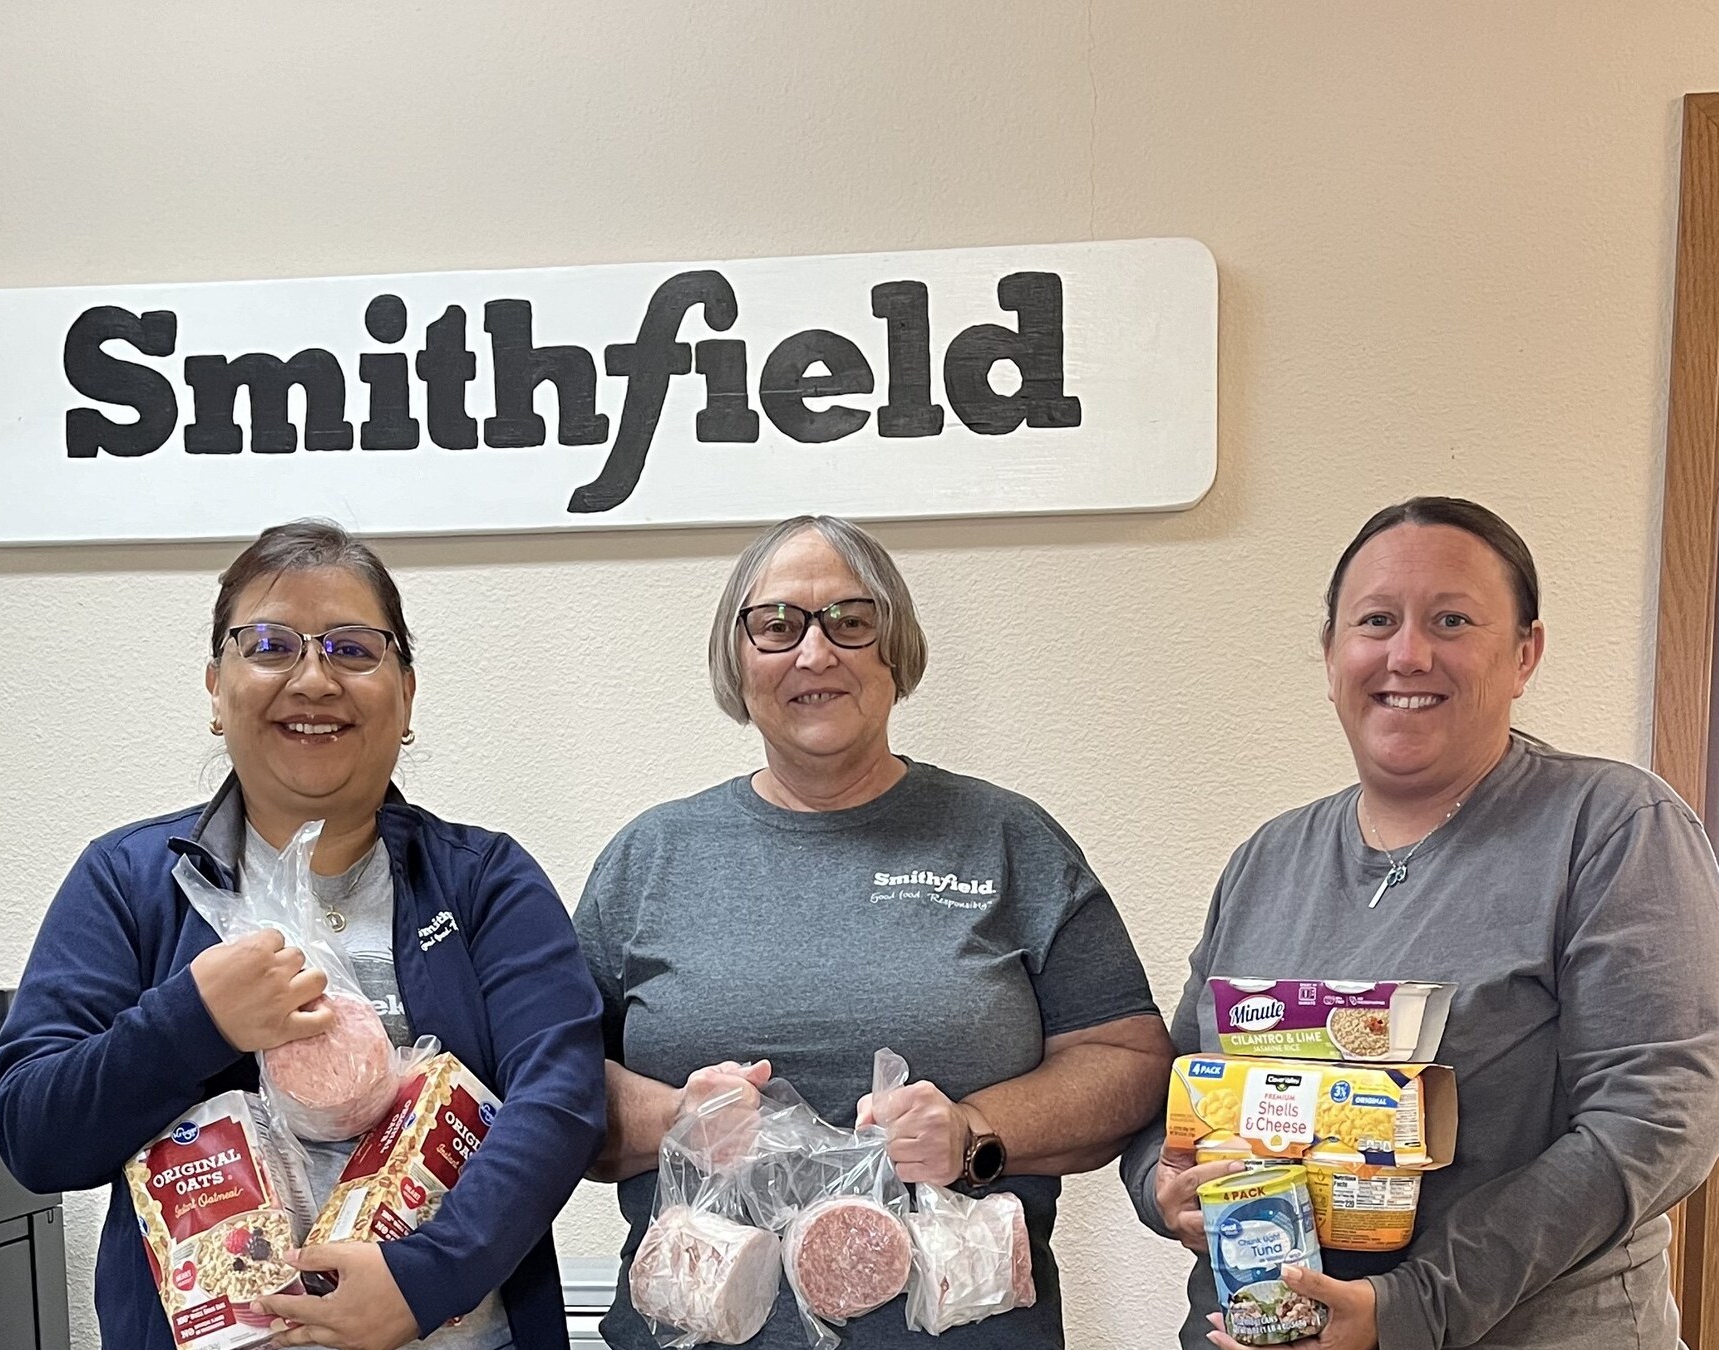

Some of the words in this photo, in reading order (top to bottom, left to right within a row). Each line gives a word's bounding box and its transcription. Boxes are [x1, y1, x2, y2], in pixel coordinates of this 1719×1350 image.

[64, 269, 1082, 515] Smithfield
[870, 891, 895, 904] Good
[1230, 1000, 1285, 1027] Minute
[1231, 1034, 1284, 1046] CILANTRO
[1286, 1033, 1295, 1044] &
[1296, 1031, 1323, 1043] LIME
[1253, 1044, 1282, 1053] JASMINE
[1283, 1043, 1301, 1052] RICE
[1191, 1063, 1200, 1075] 4
[1200, 1065, 1222, 1075] PACK
[1264, 1092, 1296, 1100] PREMIUM
[1355, 1096, 1387, 1106] ORIGINAL
[1258, 1101, 1299, 1118] Shells
[444, 1110, 482, 1152] ORIGI
[1245, 1118, 1254, 1131] &
[1256, 1117, 1307, 1134] Cheese
[152, 1148, 242, 1188] ORIGINAL
[175, 1170, 225, 1195] OATS
[197, 1186, 244, 1208] Oatmeal
[1223, 1192, 1230, 1201] 4
[1231, 1187, 1266, 1201] PACK
[1238, 1237, 1263, 1247] Chunk
[1262, 1232, 1281, 1243] Light
[1251, 1243, 1283, 1257] Tuna
